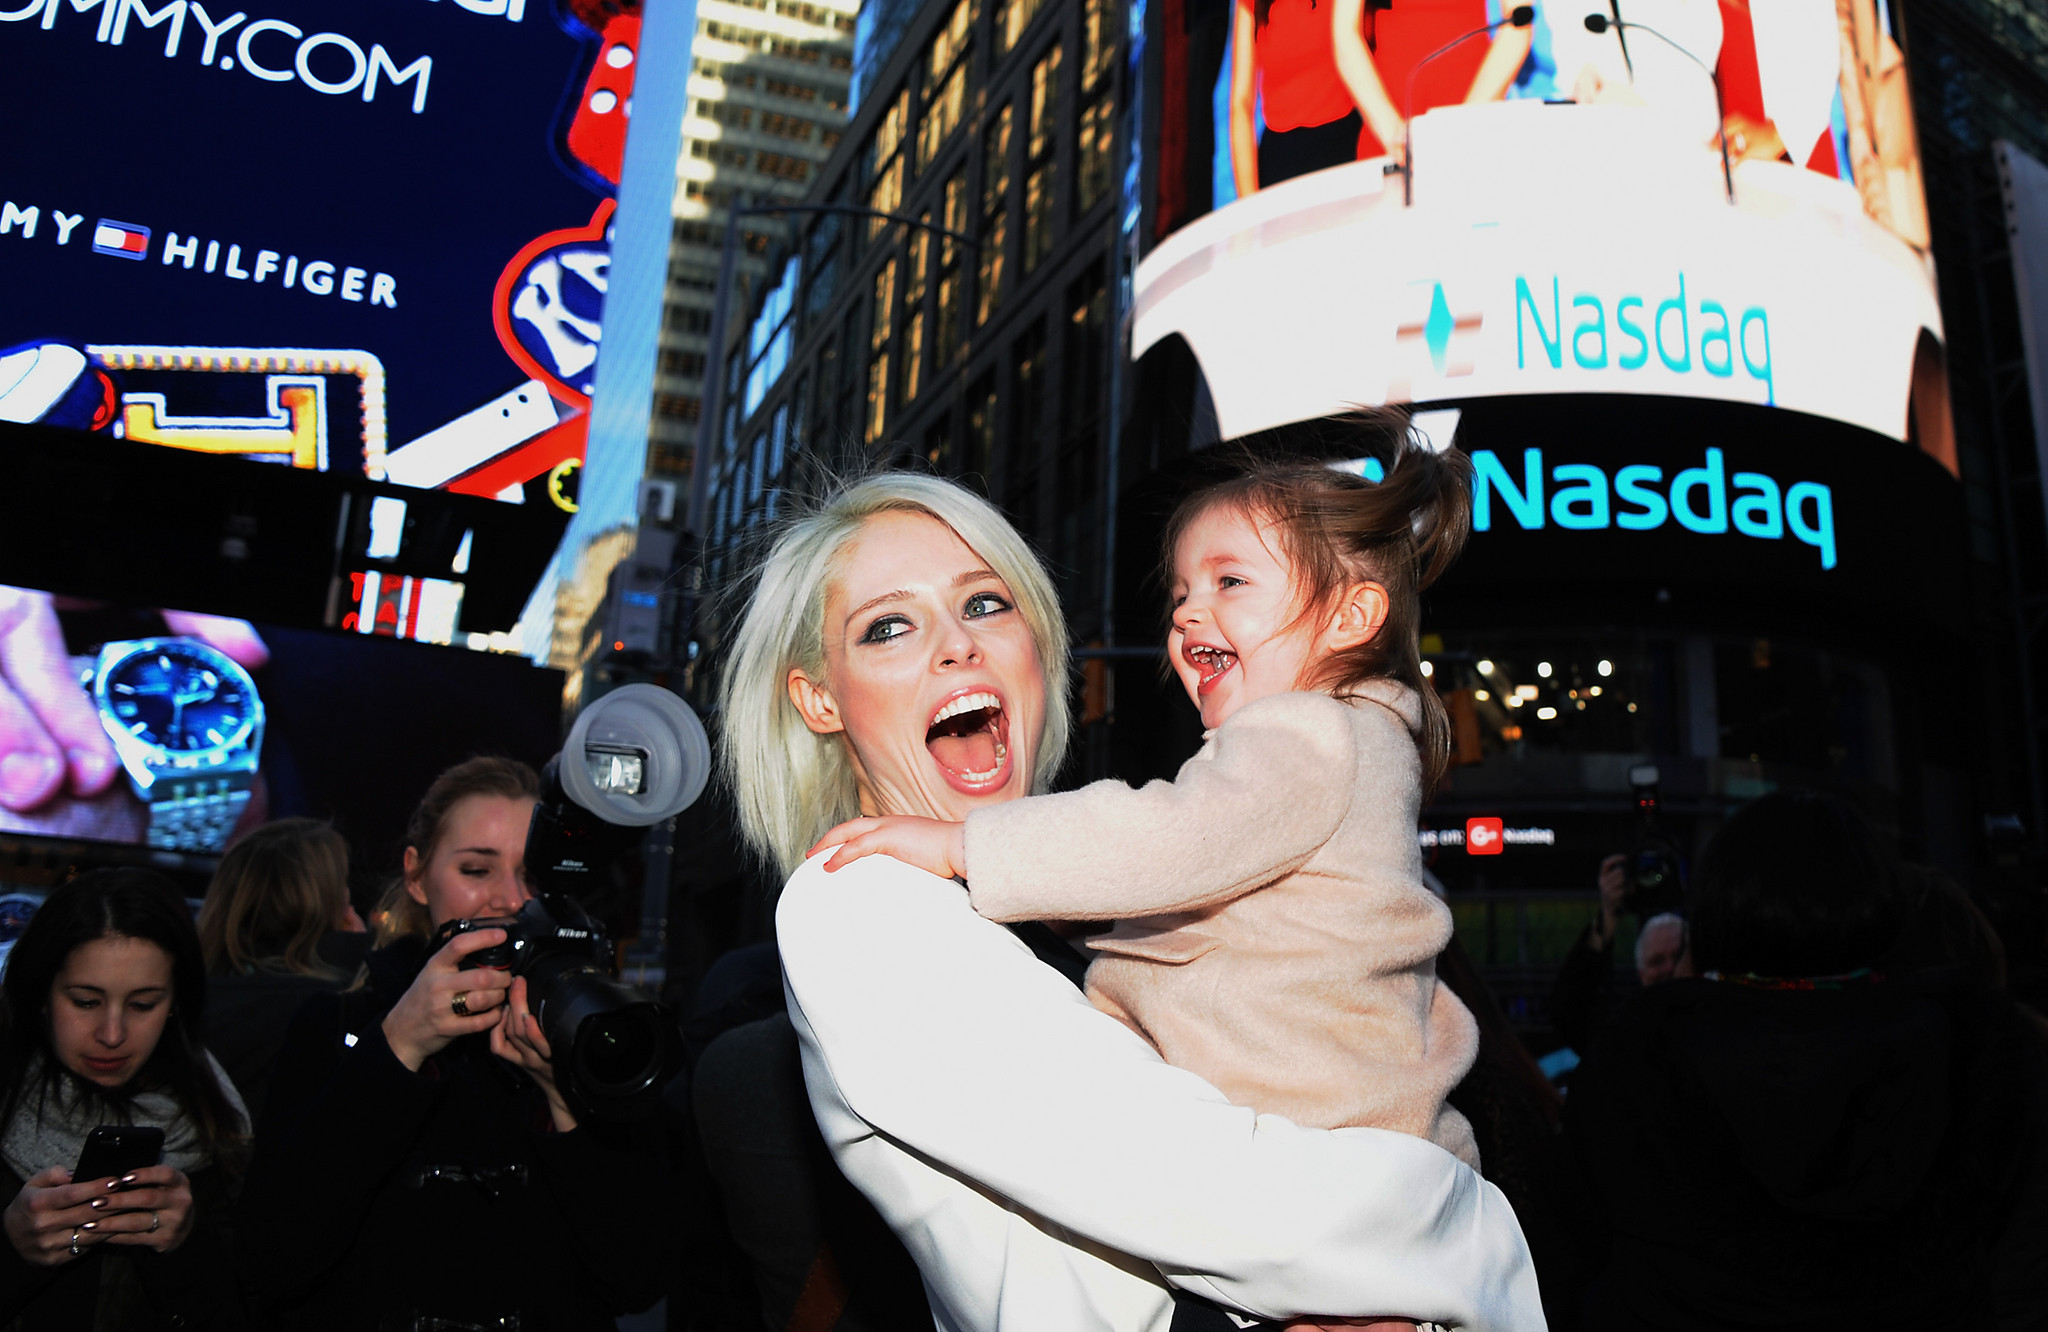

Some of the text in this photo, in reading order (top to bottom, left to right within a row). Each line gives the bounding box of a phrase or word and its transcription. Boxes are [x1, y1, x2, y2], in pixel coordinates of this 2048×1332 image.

[162, 232, 397, 309] HILFIGER
[1515, 272, 1774, 408] Nasdaq
[1471, 447, 1837, 570] Nasdaq
[557, 928, 588, 939] Nikon
